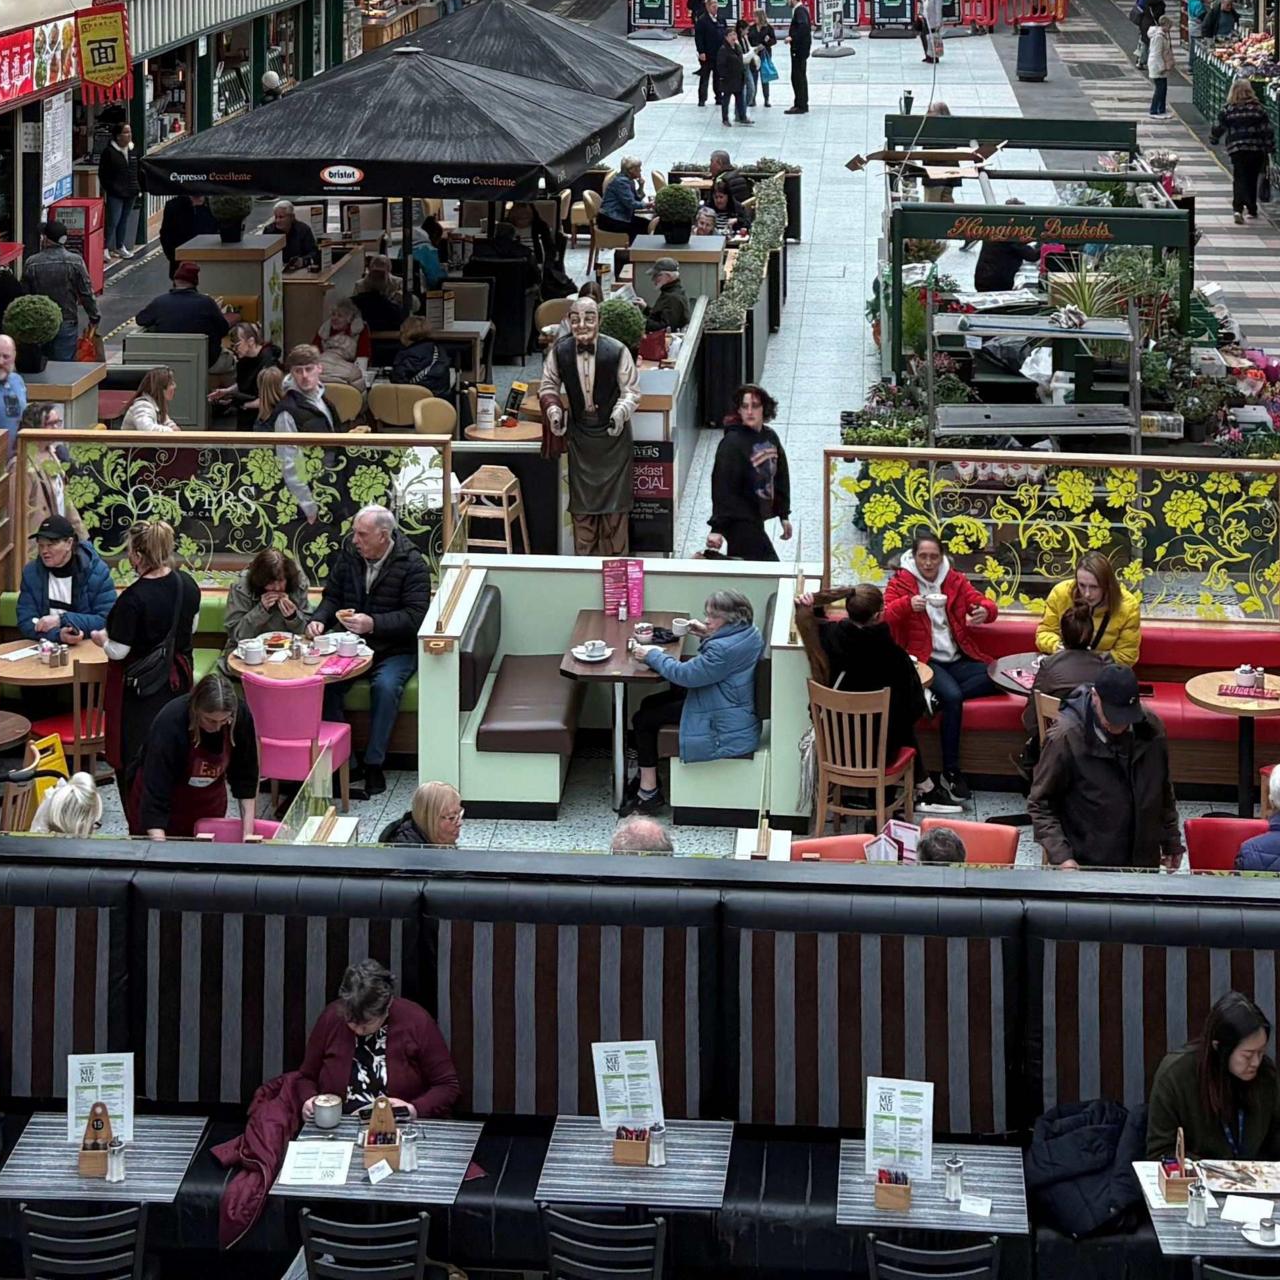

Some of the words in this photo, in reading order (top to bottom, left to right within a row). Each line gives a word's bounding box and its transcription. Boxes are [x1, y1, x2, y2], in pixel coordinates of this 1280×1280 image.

[947, 217, 1038, 243] Hanging
[1040, 217, 1115, 239] Baskets
[633, 465, 664, 476] akfast
[633, 476, 670, 490] ECIAL
[606, 1064, 620, 1072] NU
[879, 1103, 893, 1111] NU
